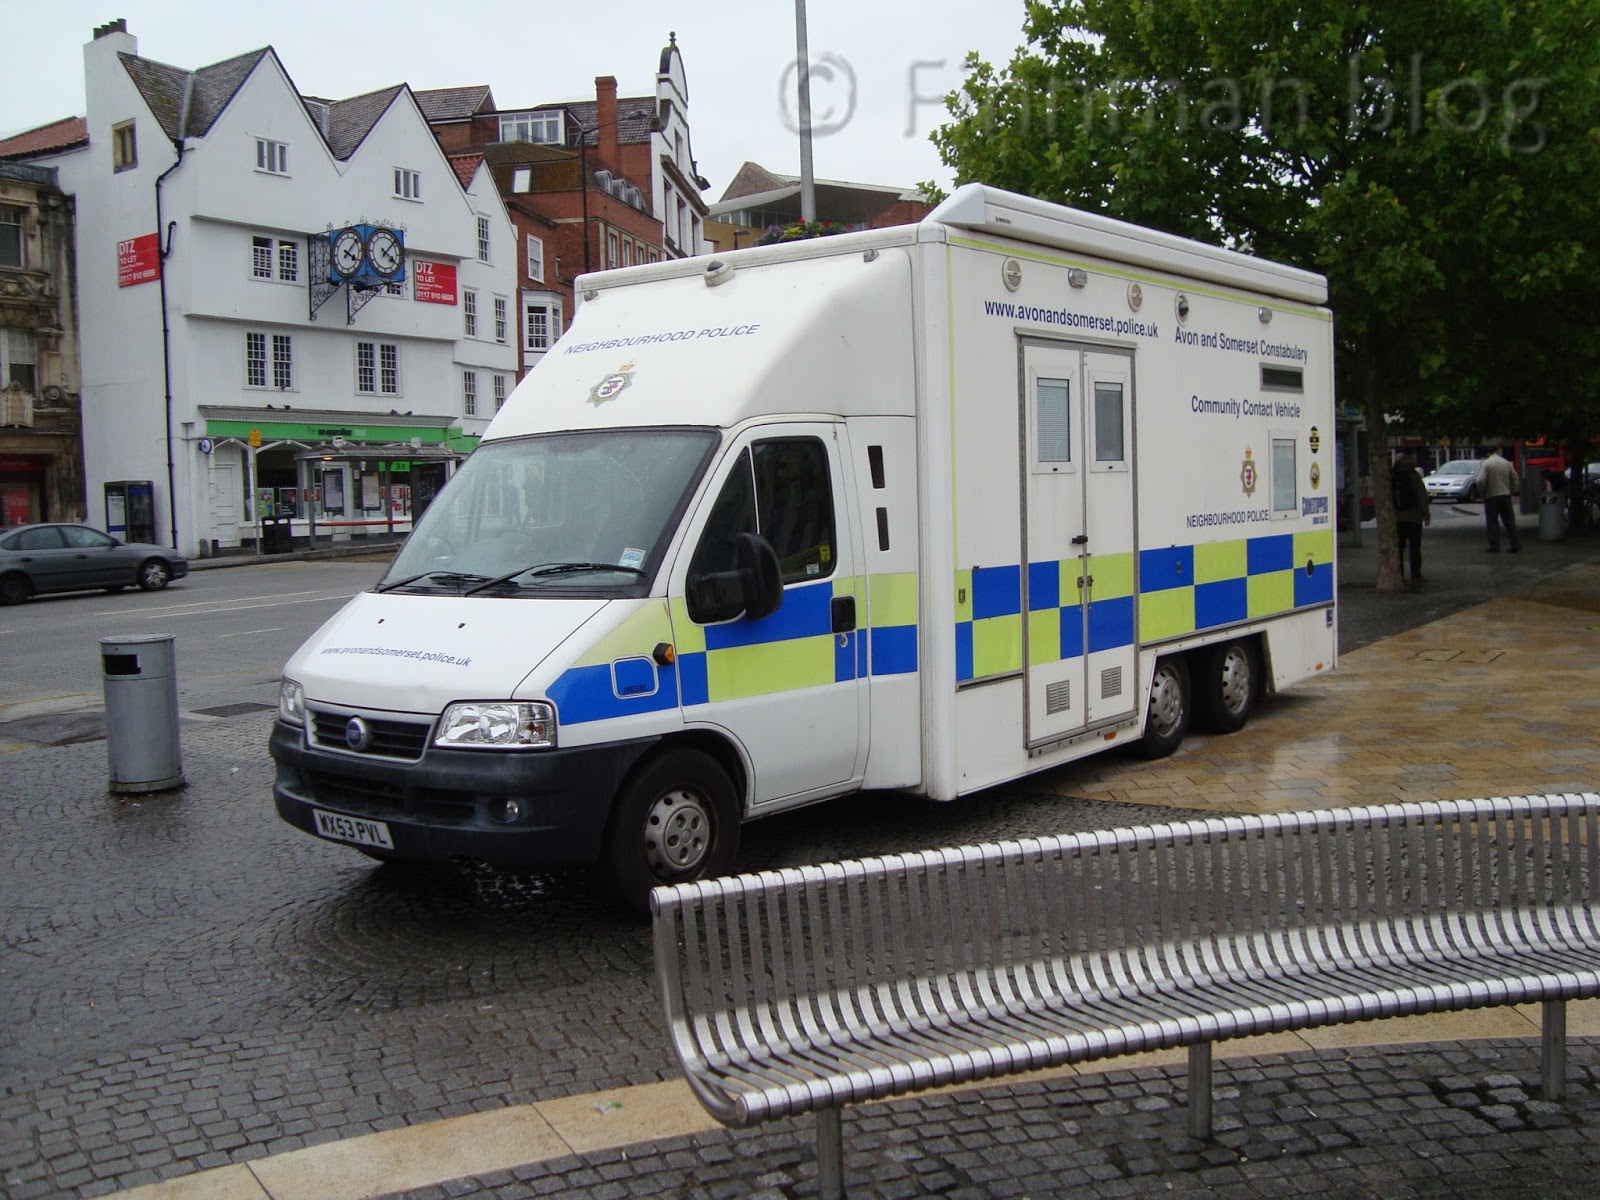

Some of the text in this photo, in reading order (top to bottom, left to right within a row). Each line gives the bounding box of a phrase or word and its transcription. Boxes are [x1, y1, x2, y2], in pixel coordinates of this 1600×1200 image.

[120, 240, 135, 255] DTZ
[127, 255, 137, 263] LET
[416, 261, 433, 274] DTZ
[985, 300, 1158, 338] www.avonandsomerset.police.uk
[563, 324, 761, 355] NEIGHBOURHOOD POLICE
[1175, 326, 1308, 364] Avon and Somerset Constabulary
[1191, 395, 1300, 419] Community Contact Vehicle
[1186, 510, 1269, 528] NEIGHBOURHOOD POLICE
[320, 646, 473, 667] www.avonandsomerset.police.uk
[623, 684, 648, 694] DIESEL
[318, 813, 388, 845] WX53 PVL
